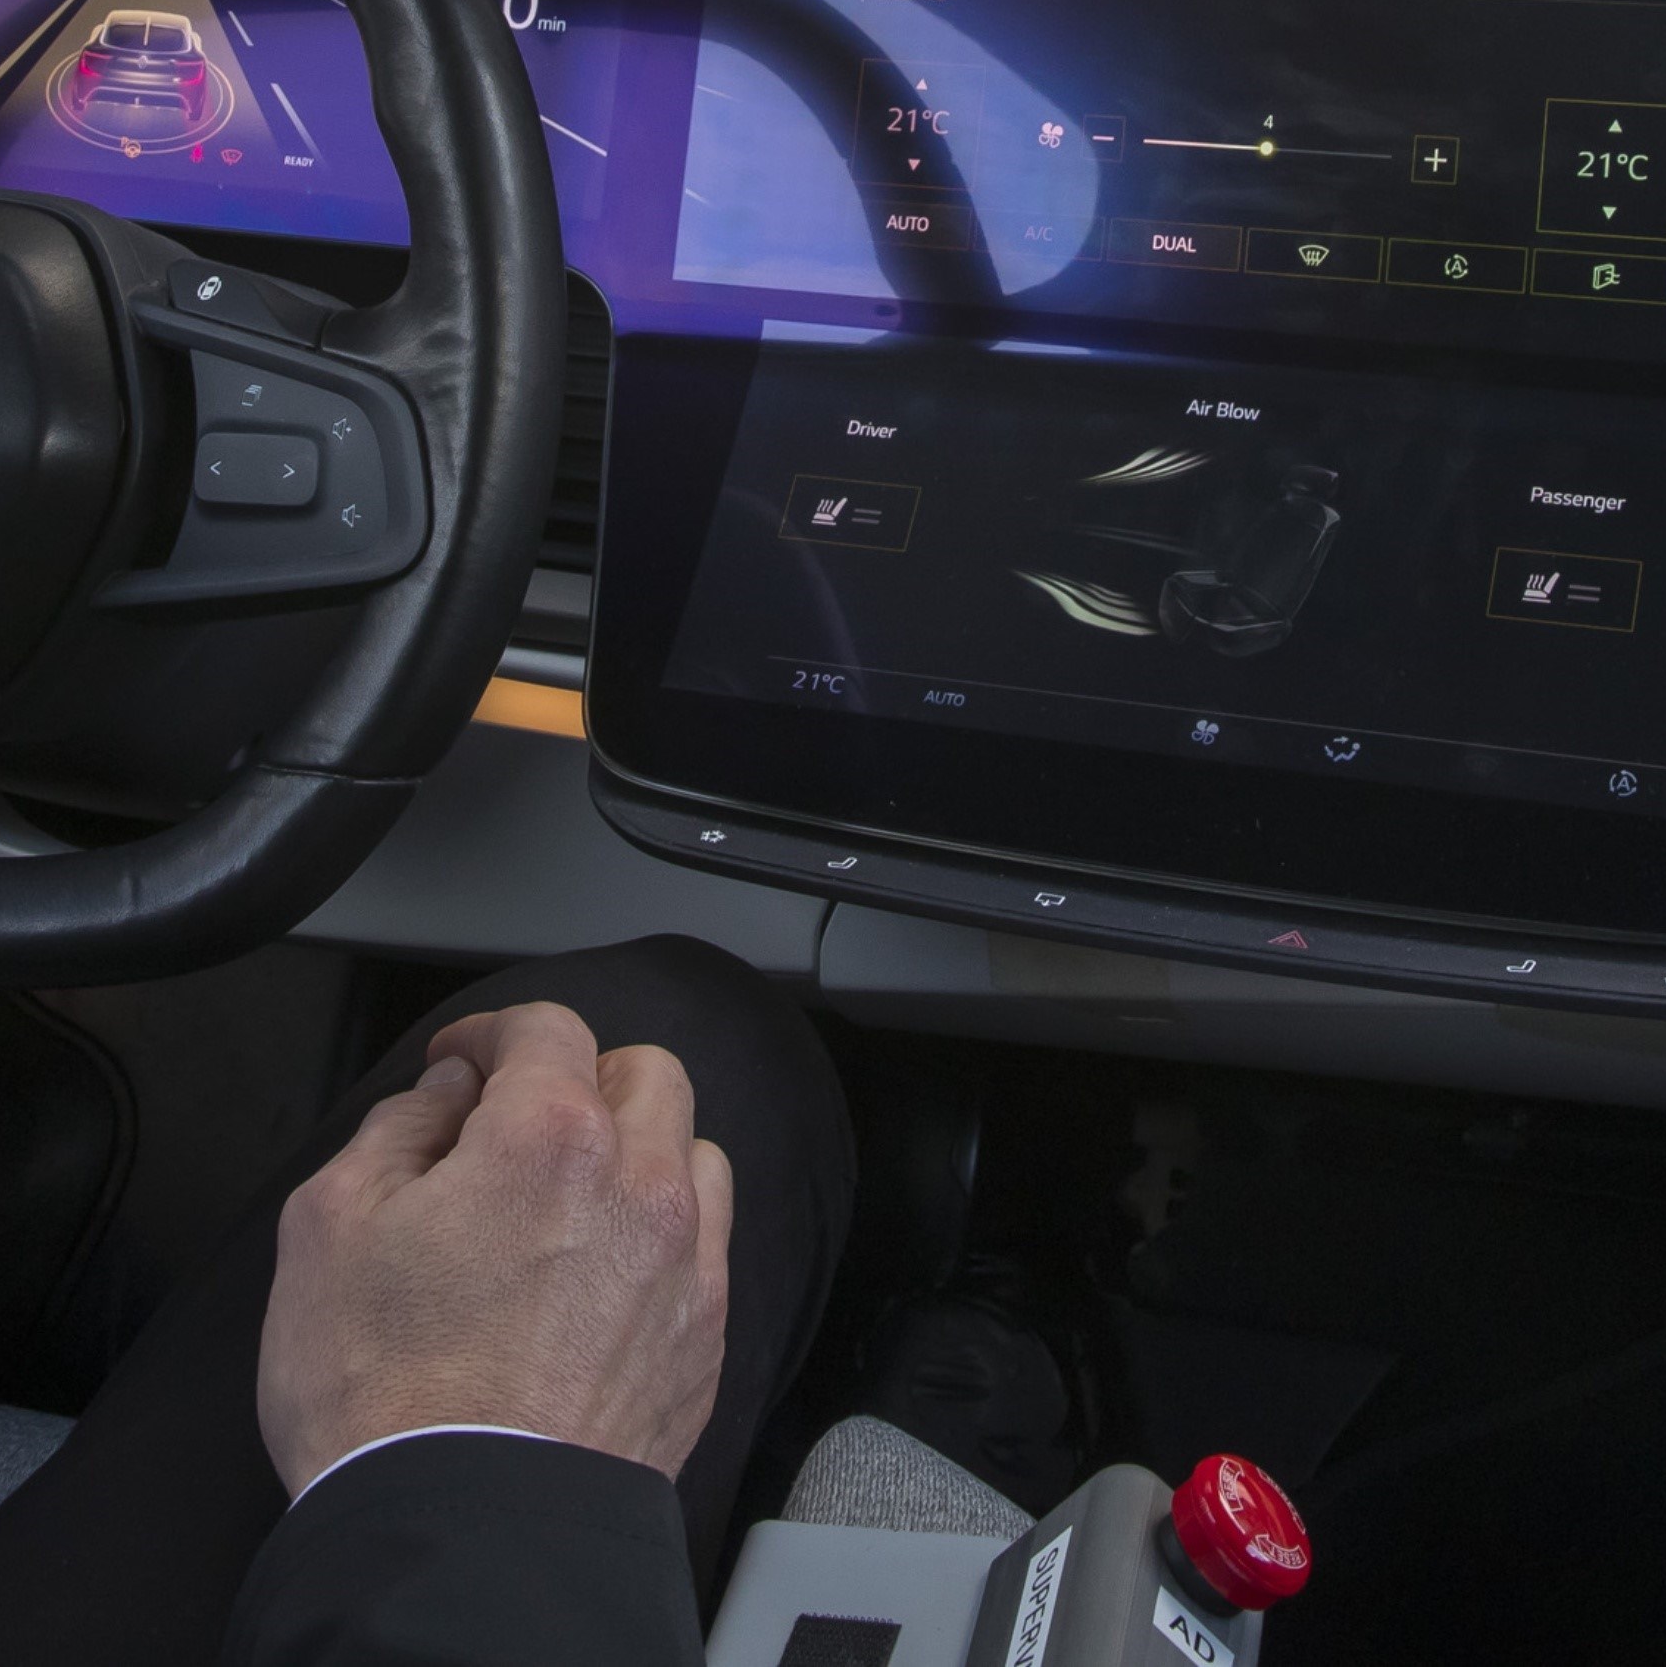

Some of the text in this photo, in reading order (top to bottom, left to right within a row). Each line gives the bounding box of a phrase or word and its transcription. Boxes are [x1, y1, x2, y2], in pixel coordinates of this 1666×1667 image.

[537, 16, 567, 33] min
[886, 107, 950, 135] 21°C
[1264, 114, 1276, 130] 4
[284, 154, 315, 168] READY
[1576, 150, 1649, 181] 21°C
[886, 214, 930, 233] AUTO
[1024, 225, 1053, 243] A/C
[1152, 233, 1197, 254] DUAL
[1186, 398, 1260, 422] Air Blow
[846, 419, 897, 440] Driver
[1530, 485, 1626, 514] Passenger
[792, 669, 845, 695] 21°C
[923, 689, 966, 708] AUTO
[1013, 1546, 1059, 1667] SUPERV
[1169, 1615, 1215, 1663] AD
